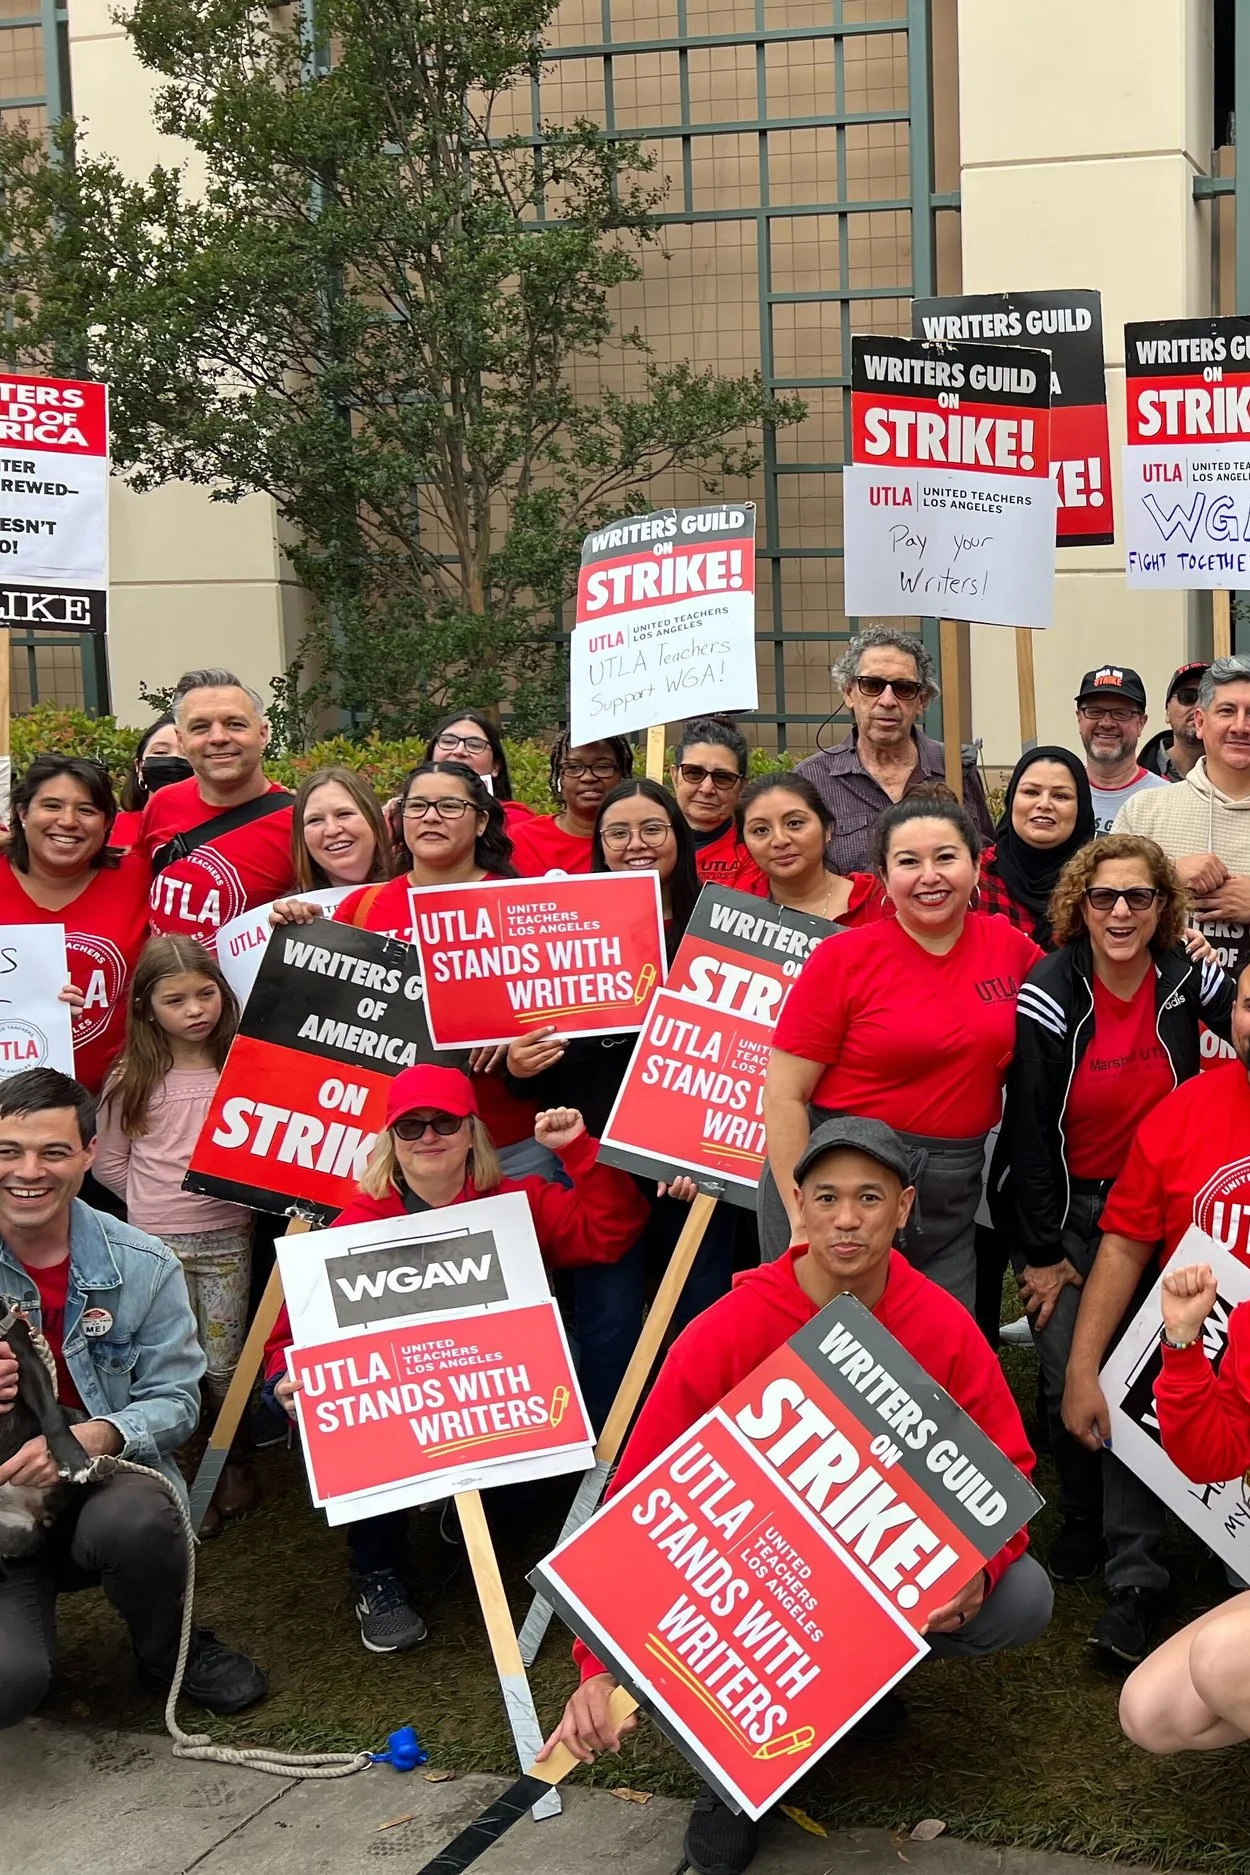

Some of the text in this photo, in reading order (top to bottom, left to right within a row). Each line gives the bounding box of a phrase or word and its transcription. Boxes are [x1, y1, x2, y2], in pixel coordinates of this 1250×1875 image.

[922, 308, 1091, 340] WRITERS GUILD
[1136, 338, 1227, 364] WRITERS
[864, 355, 965, 387] WRITERS
[970, 364, 1036, 393] GUILD
[1204, 367, 1222, 382] ON
[39, 412, 77, 426] OF
[938, 392, 959, 409] ON
[864, 408, 1035, 471] STRIKE!
[1143, 464, 1182, 482] UTLA
[1192, 462, 1230, 471] UNITED
[1193, 473, 1212, 482] LOS
[869, 487, 1032, 506] UTLA UNITED TEACHERS
[923, 498, 1002, 513] LOS ANGELES
[592, 511, 744, 553] WRITERS GUILD
[653, 542, 672, 556] ON
[889, 525, 993, 561] Pay your
[586, 550, 743, 611] STRIKE!
[1129, 552, 1166, 572] FIGHT
[901, 569, 988, 600] Writers!
[589, 607, 728, 653] UTLA UNITED TEACHERS
[633, 620, 703, 642] LOS ANGELES
[589, 638, 731, 686] UTLA Teachers
[590, 661, 724, 717] Support WGA!
[1094, 677, 1122, 688] STRIKE
[150, 875, 220, 926] UTLA
[508, 912, 578, 925] TEACHERS
[229, 926, 266, 956] UTLA
[420, 908, 495, 944] UTLA
[507, 902, 556, 914] UNITED
[508, 921, 600, 935] LOS ANGELES
[284, 938, 402, 993] WRITERS
[432, 937, 621, 982] STANDS WITH
[357, 998, 388, 1021] OF
[506, 971, 633, 1010] WRITERS
[298, 1014, 417, 1066] AMERICA
[649, 1015, 722, 1063] UTLA
[642, 1055, 752, 1110] STANDS
[731, 1062, 757, 1074] LOS
[318, 1079, 368, 1117] ON
[336, 1254, 491, 1301] WGAW
[301, 1339, 455, 1397] UTLA UNITED
[403, 1346, 479, 1364] TEACHERS
[406, 1352, 503, 1375] LOS ANGELES
[316, 1365, 531, 1433] STANDS WITH
[409, 1395, 549, 1445] WRITERS
[818, 1322, 1009, 1527] WRITERS GUILD
[870, 1433, 902, 1469] ON
[668, 1441, 812, 1580] UTLA UNITED
[734, 1378, 960, 1610] STRIKE!
[631, 1488, 821, 1699] STANDS WITH
[753, 1537, 818, 1612] TEACHERS
[740, 1548, 824, 1643] LOS ANGELES
[655, 1594, 788, 1743] WRITERS
